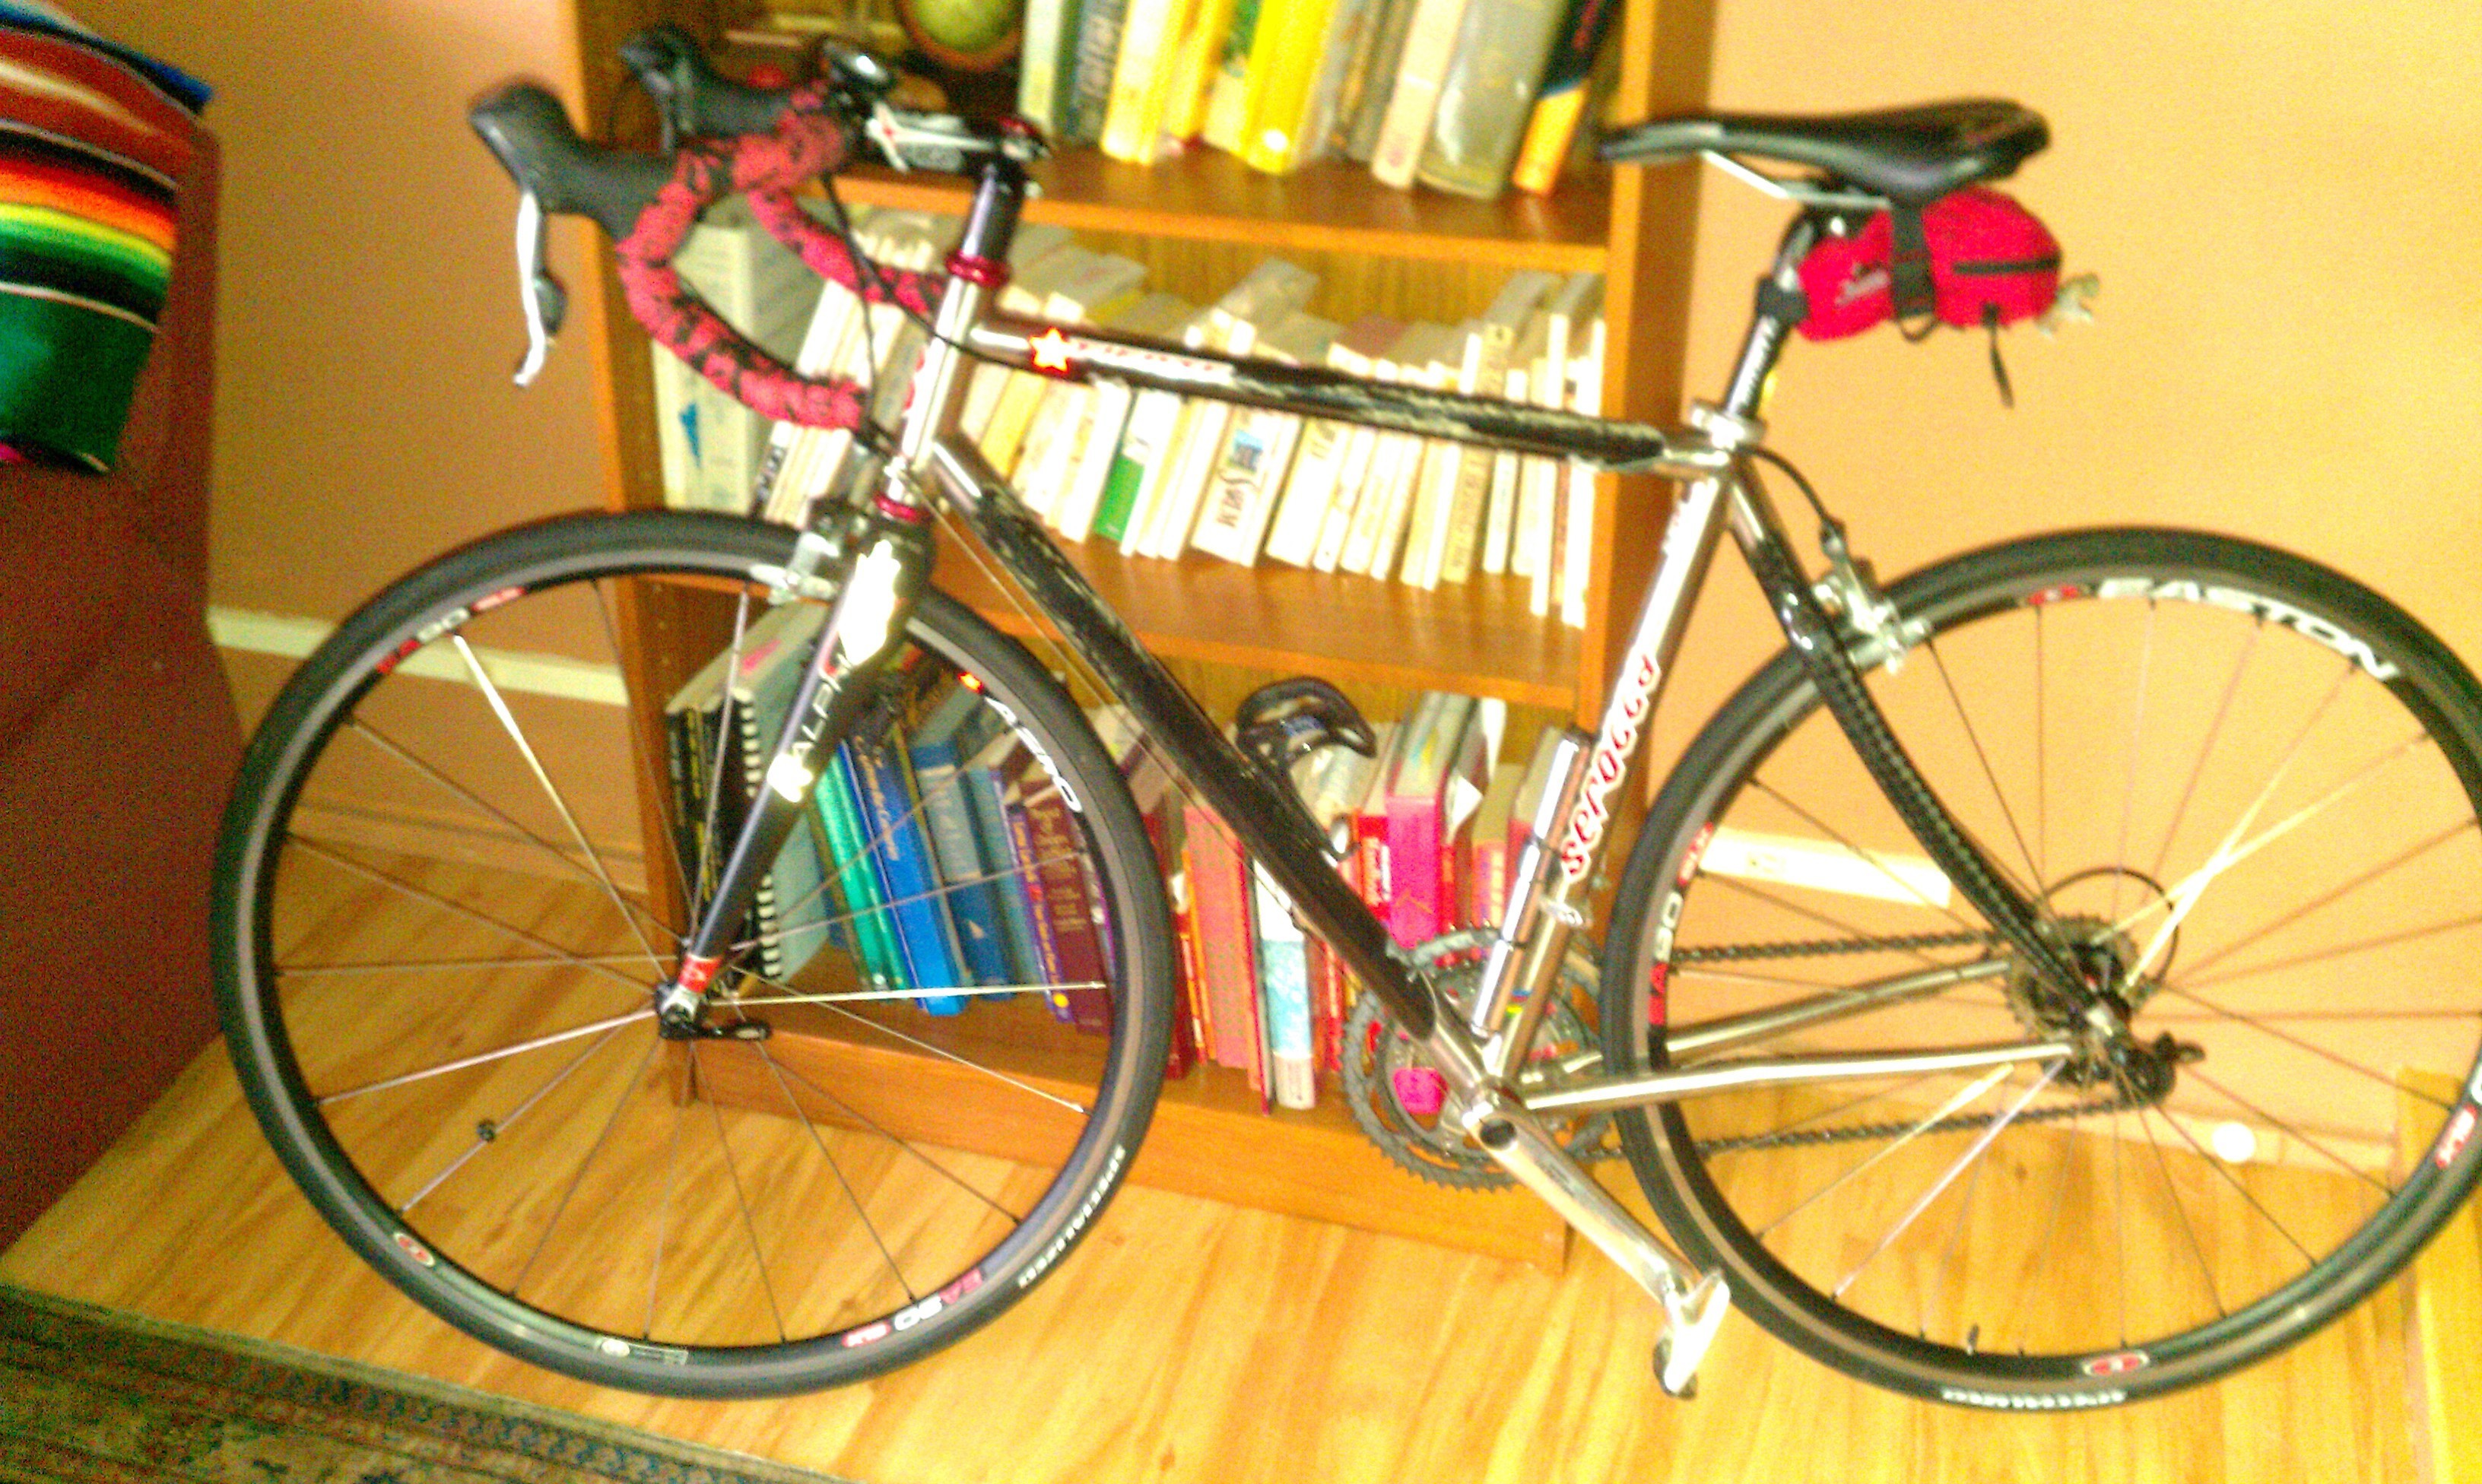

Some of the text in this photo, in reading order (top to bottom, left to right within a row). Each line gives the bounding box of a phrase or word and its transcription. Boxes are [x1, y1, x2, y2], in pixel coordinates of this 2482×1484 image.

[2096, 578, 2401, 681] EASTON
[986, 697, 1081, 813] AERO
[893, 1270, 983, 1330] EA90
